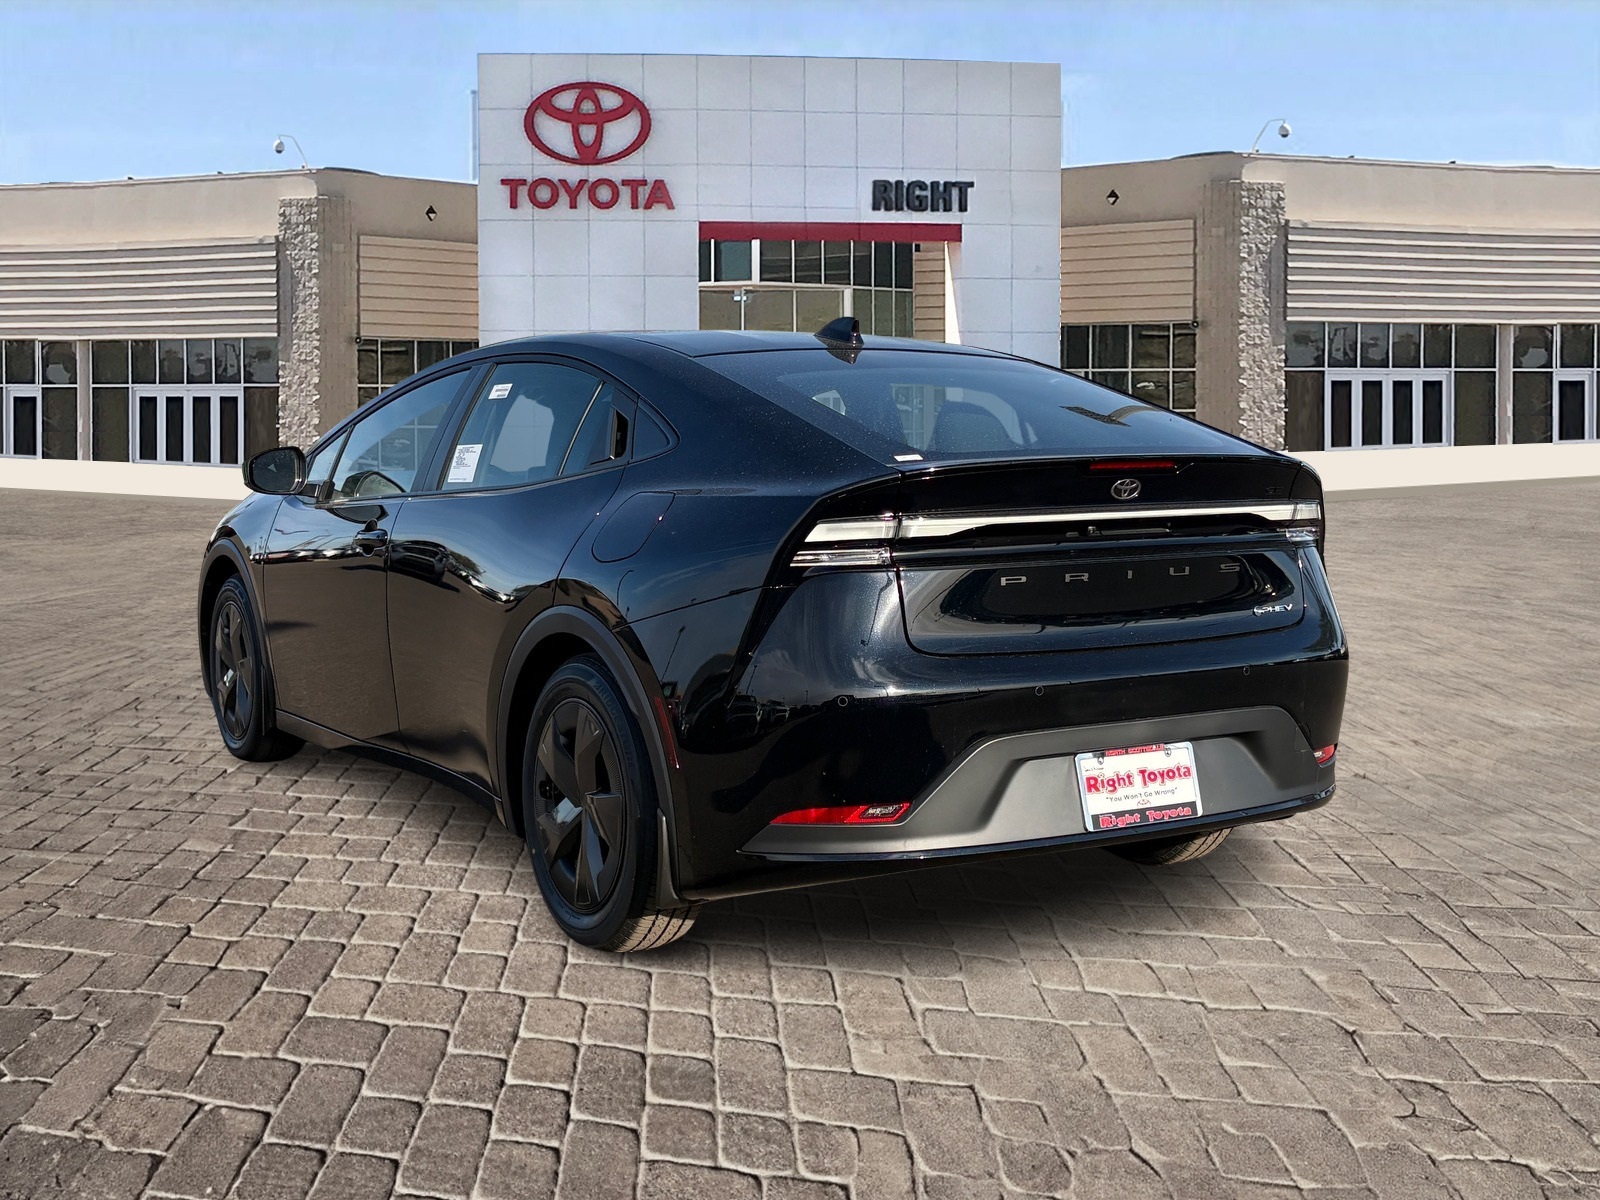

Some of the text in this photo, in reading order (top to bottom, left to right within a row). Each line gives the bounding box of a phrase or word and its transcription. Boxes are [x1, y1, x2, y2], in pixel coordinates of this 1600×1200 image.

[501, 178, 675, 210] TOYOTA
[872, 179, 975, 212] RIGHT
[1000, 563, 1241, 586] PRIUS
[1084, 765, 1192, 794] Right Toyota
[1124, 792, 1143, 800] Won't
[1100, 814, 1140, 828] Right
[1146, 806, 1192, 821] Toyota
